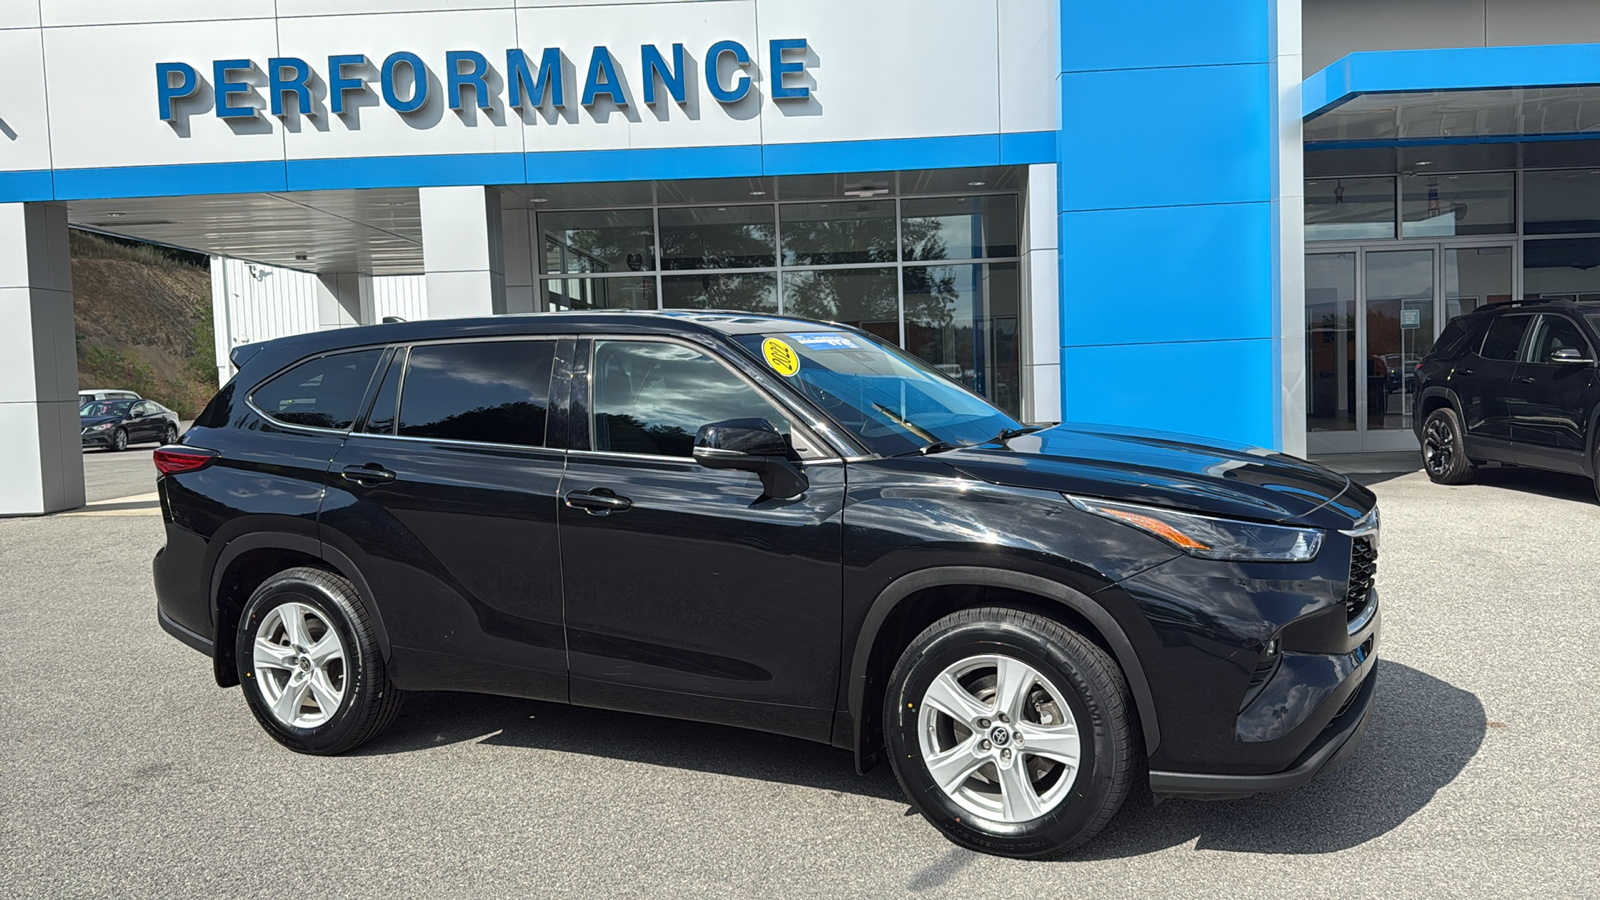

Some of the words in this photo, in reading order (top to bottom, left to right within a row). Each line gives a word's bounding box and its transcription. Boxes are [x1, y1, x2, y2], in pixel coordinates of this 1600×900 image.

[155, 38, 811, 122] PERFORMANCE
[768, 341, 793, 371] 2022
[1060, 661, 1105, 737] SUMMIT
